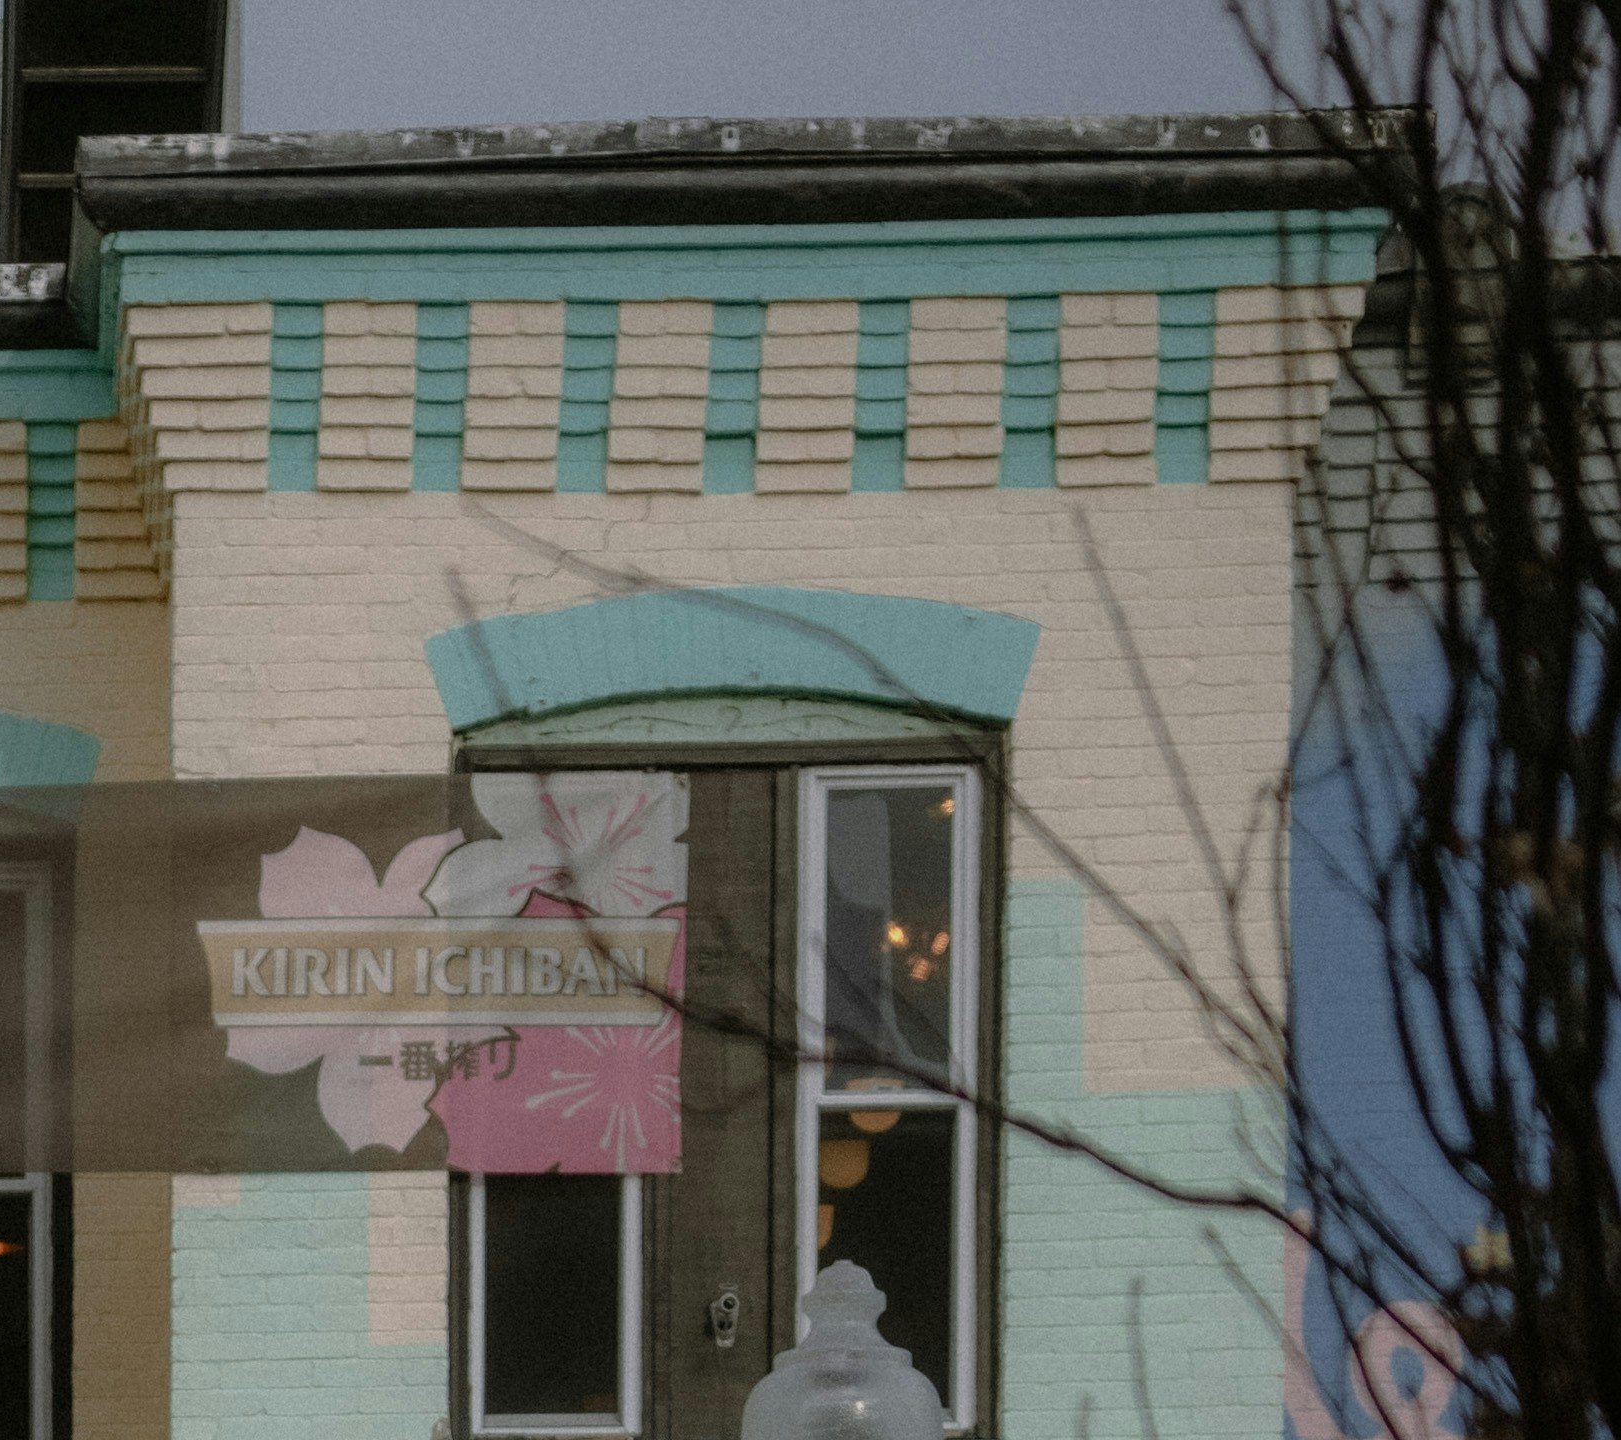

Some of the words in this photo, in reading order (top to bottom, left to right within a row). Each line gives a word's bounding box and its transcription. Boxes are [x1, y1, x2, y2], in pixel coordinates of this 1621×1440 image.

[232, 947, 395, 997] KIRIN
[414, 946, 647, 998] ICHIBAN
[359, 1039, 520, 1081] 一番搾り
